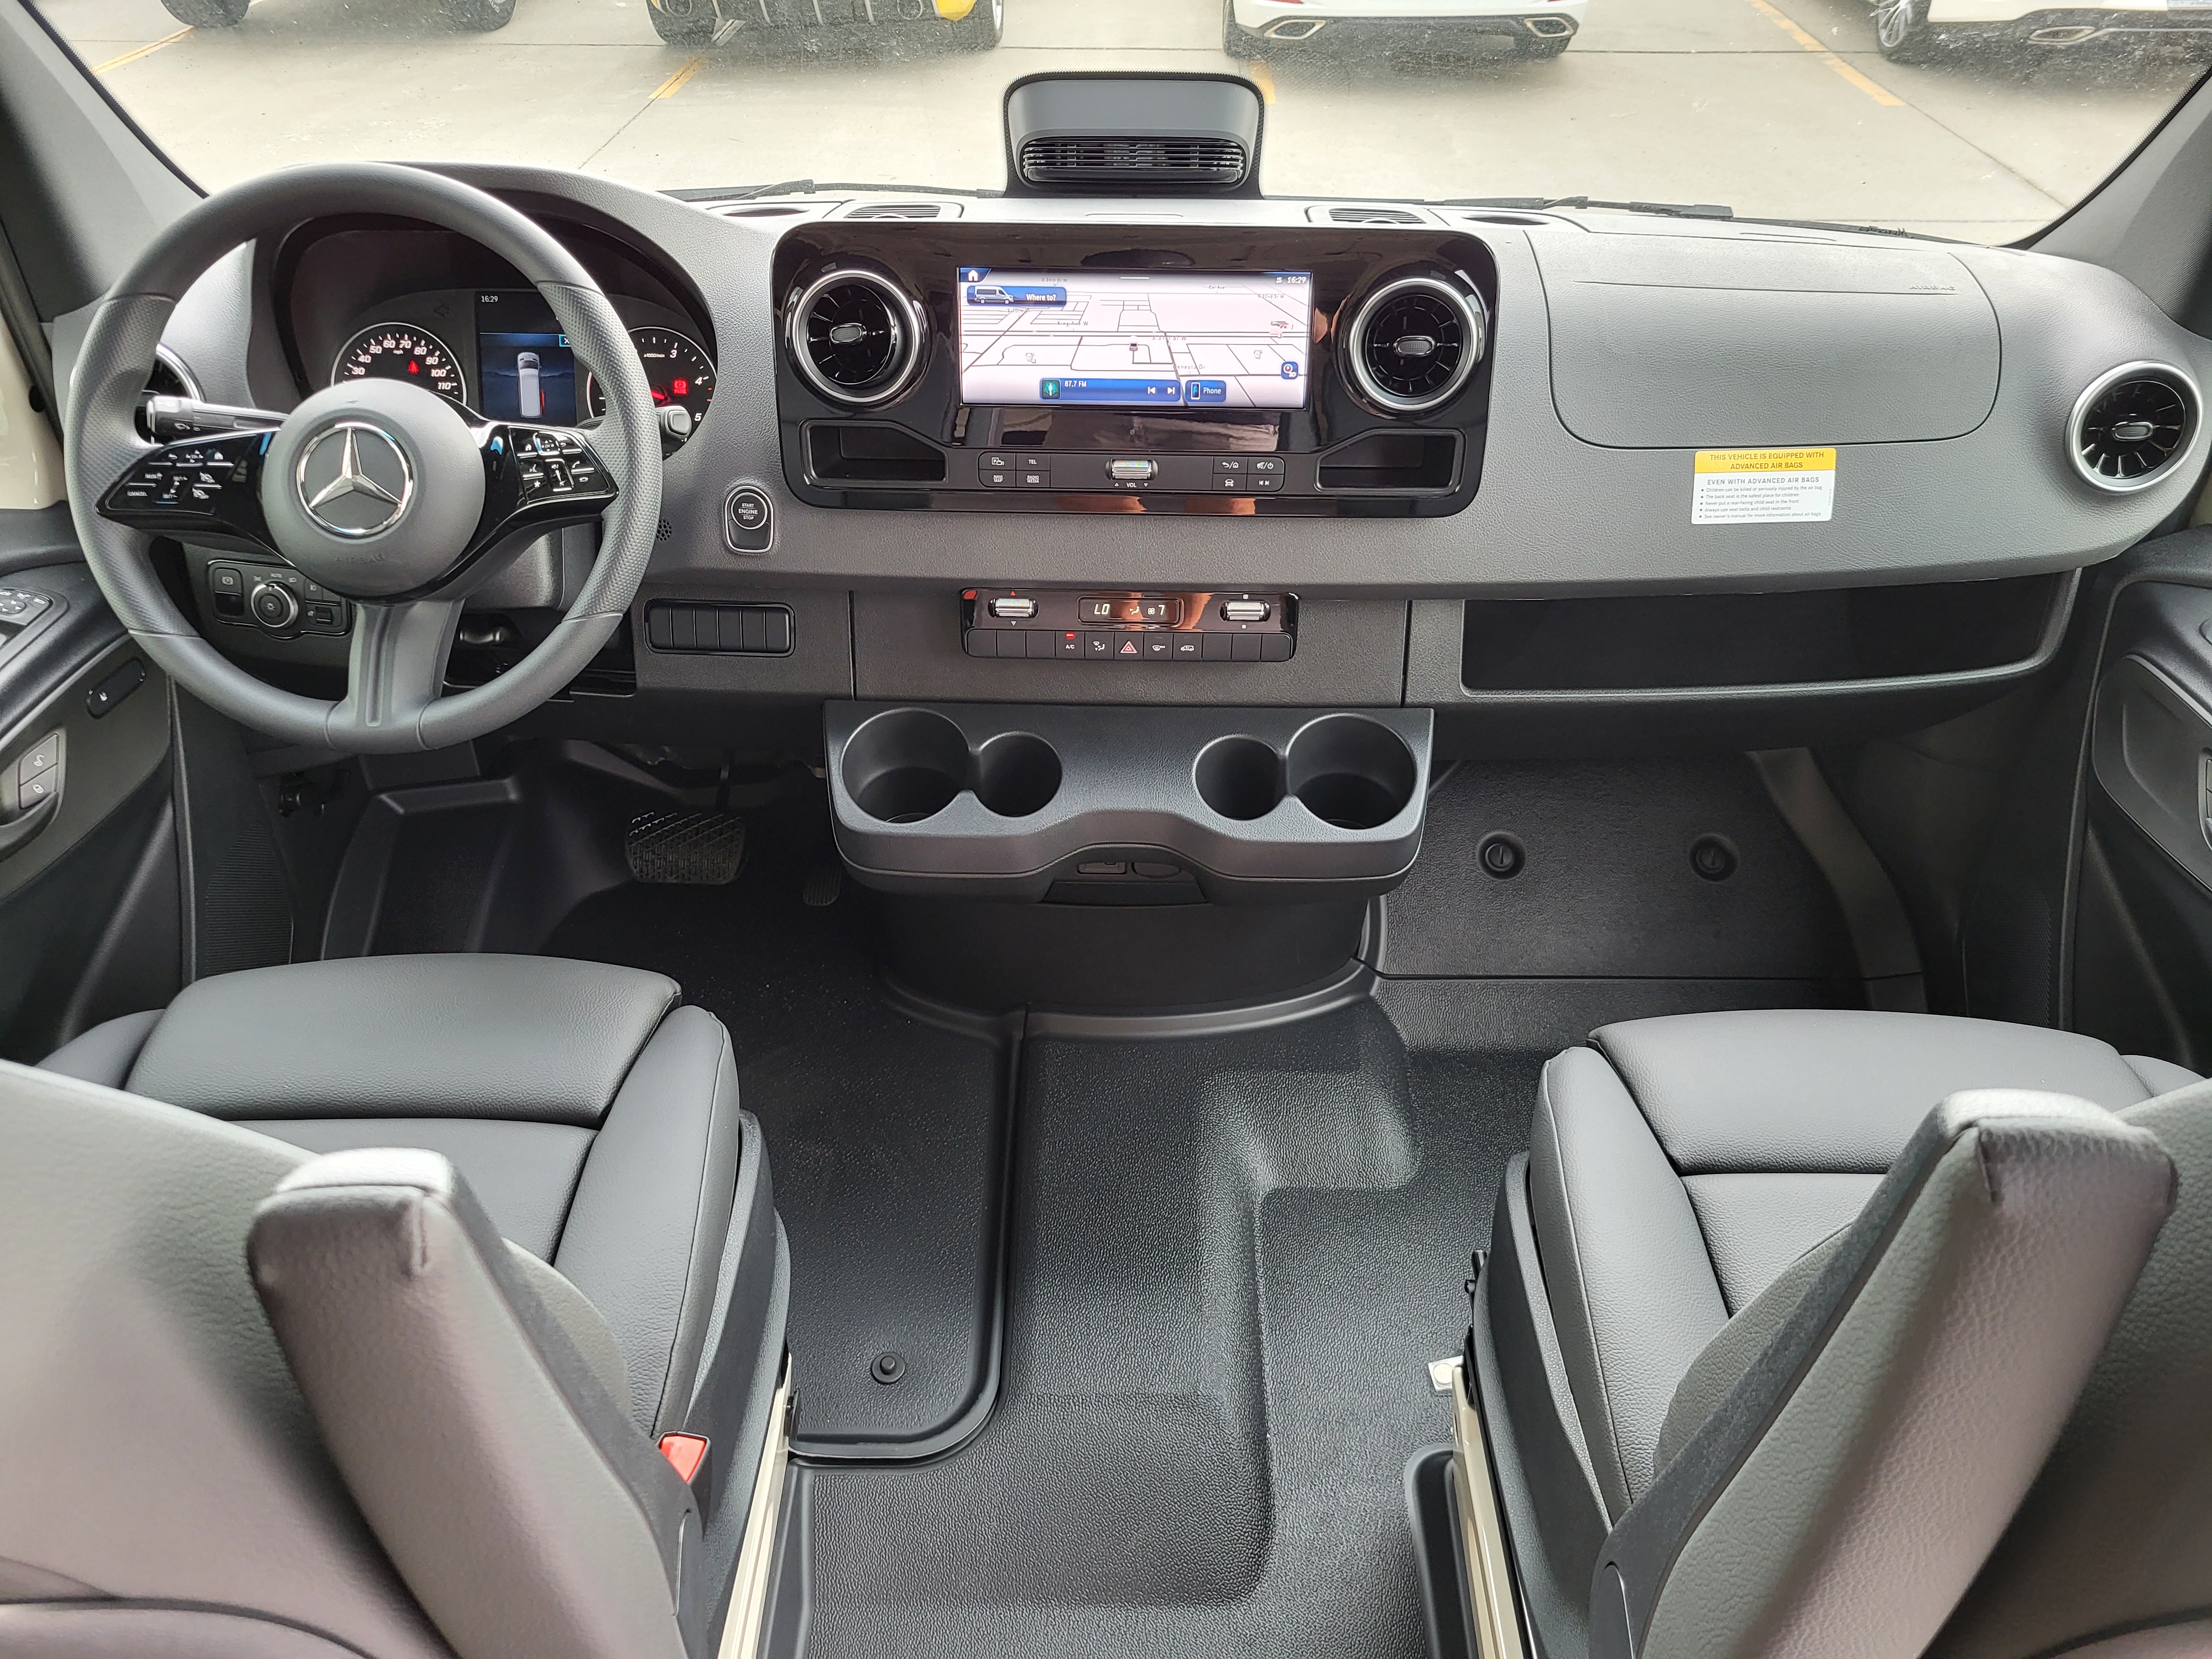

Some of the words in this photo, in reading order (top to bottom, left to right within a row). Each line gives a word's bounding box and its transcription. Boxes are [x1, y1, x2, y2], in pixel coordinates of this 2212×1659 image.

[383, 340, 396, 348] 60
[399, 340, 412, 349] 70
[369, 346, 383, 354] 50
[670, 349, 677, 358] 3
[358, 354, 372, 363] 40
[425, 357, 439, 365] 90
[351, 367, 366, 375] 30
[430, 369, 447, 377] 100
[695, 377, 703, 385] 4
[694, 413, 702, 421] 5
[1094, 603, 1110, 615] LO
[1158, 604, 1166, 615] 7
